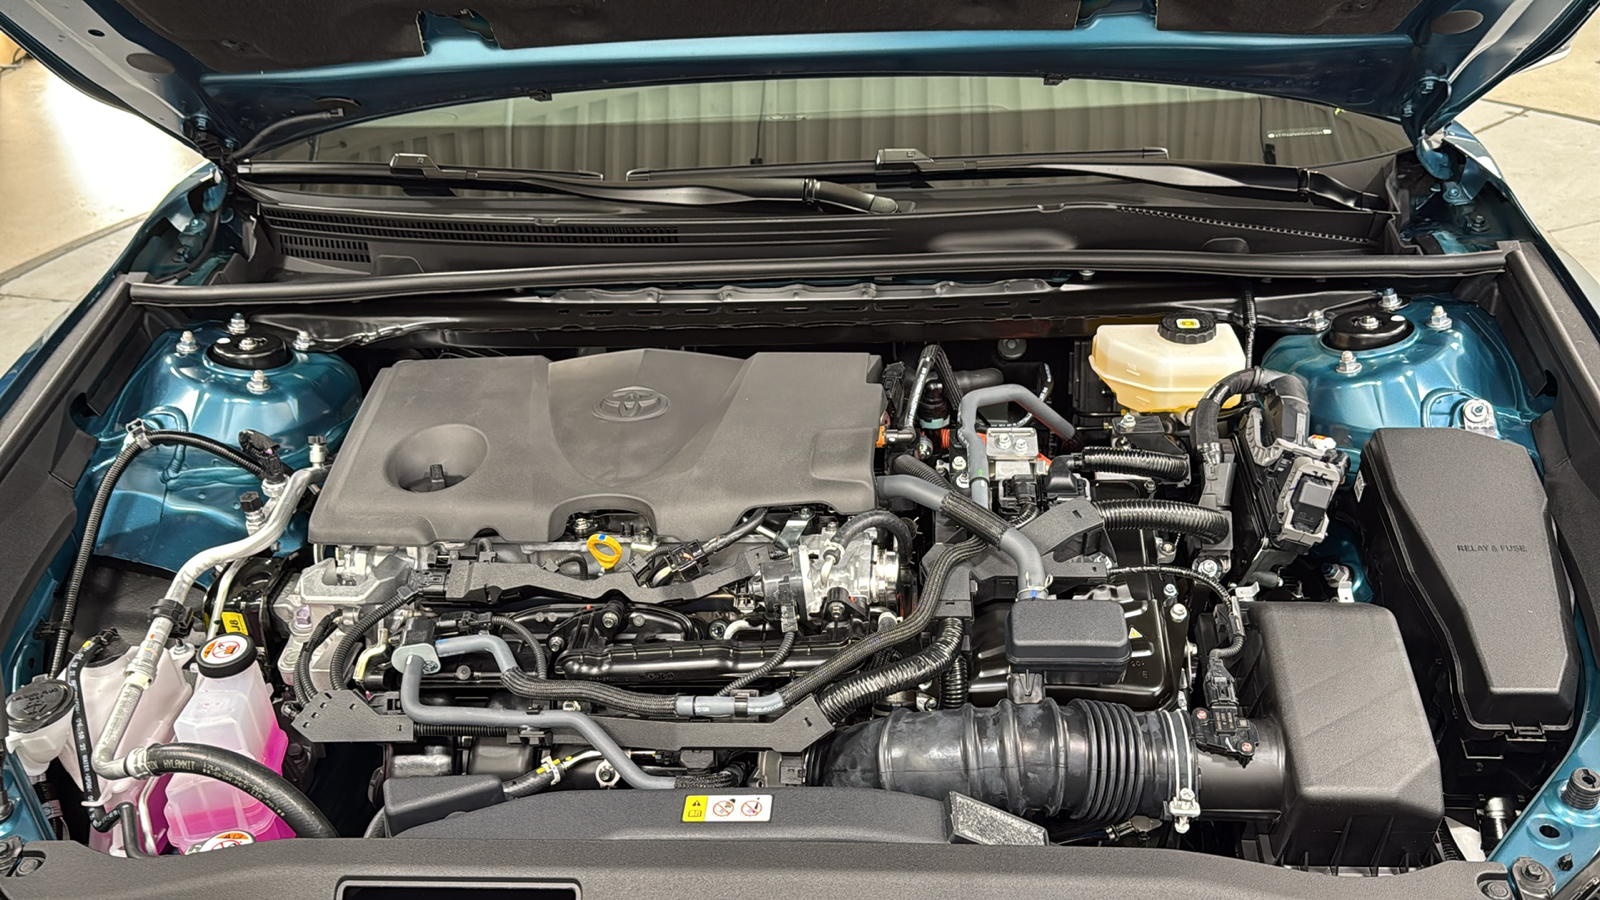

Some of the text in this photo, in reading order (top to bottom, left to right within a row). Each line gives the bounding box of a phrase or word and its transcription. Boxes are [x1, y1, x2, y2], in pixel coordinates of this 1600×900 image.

[1456, 544, 1528, 552] RELAY & FUSE
[229, 619, 241, 631] J8
